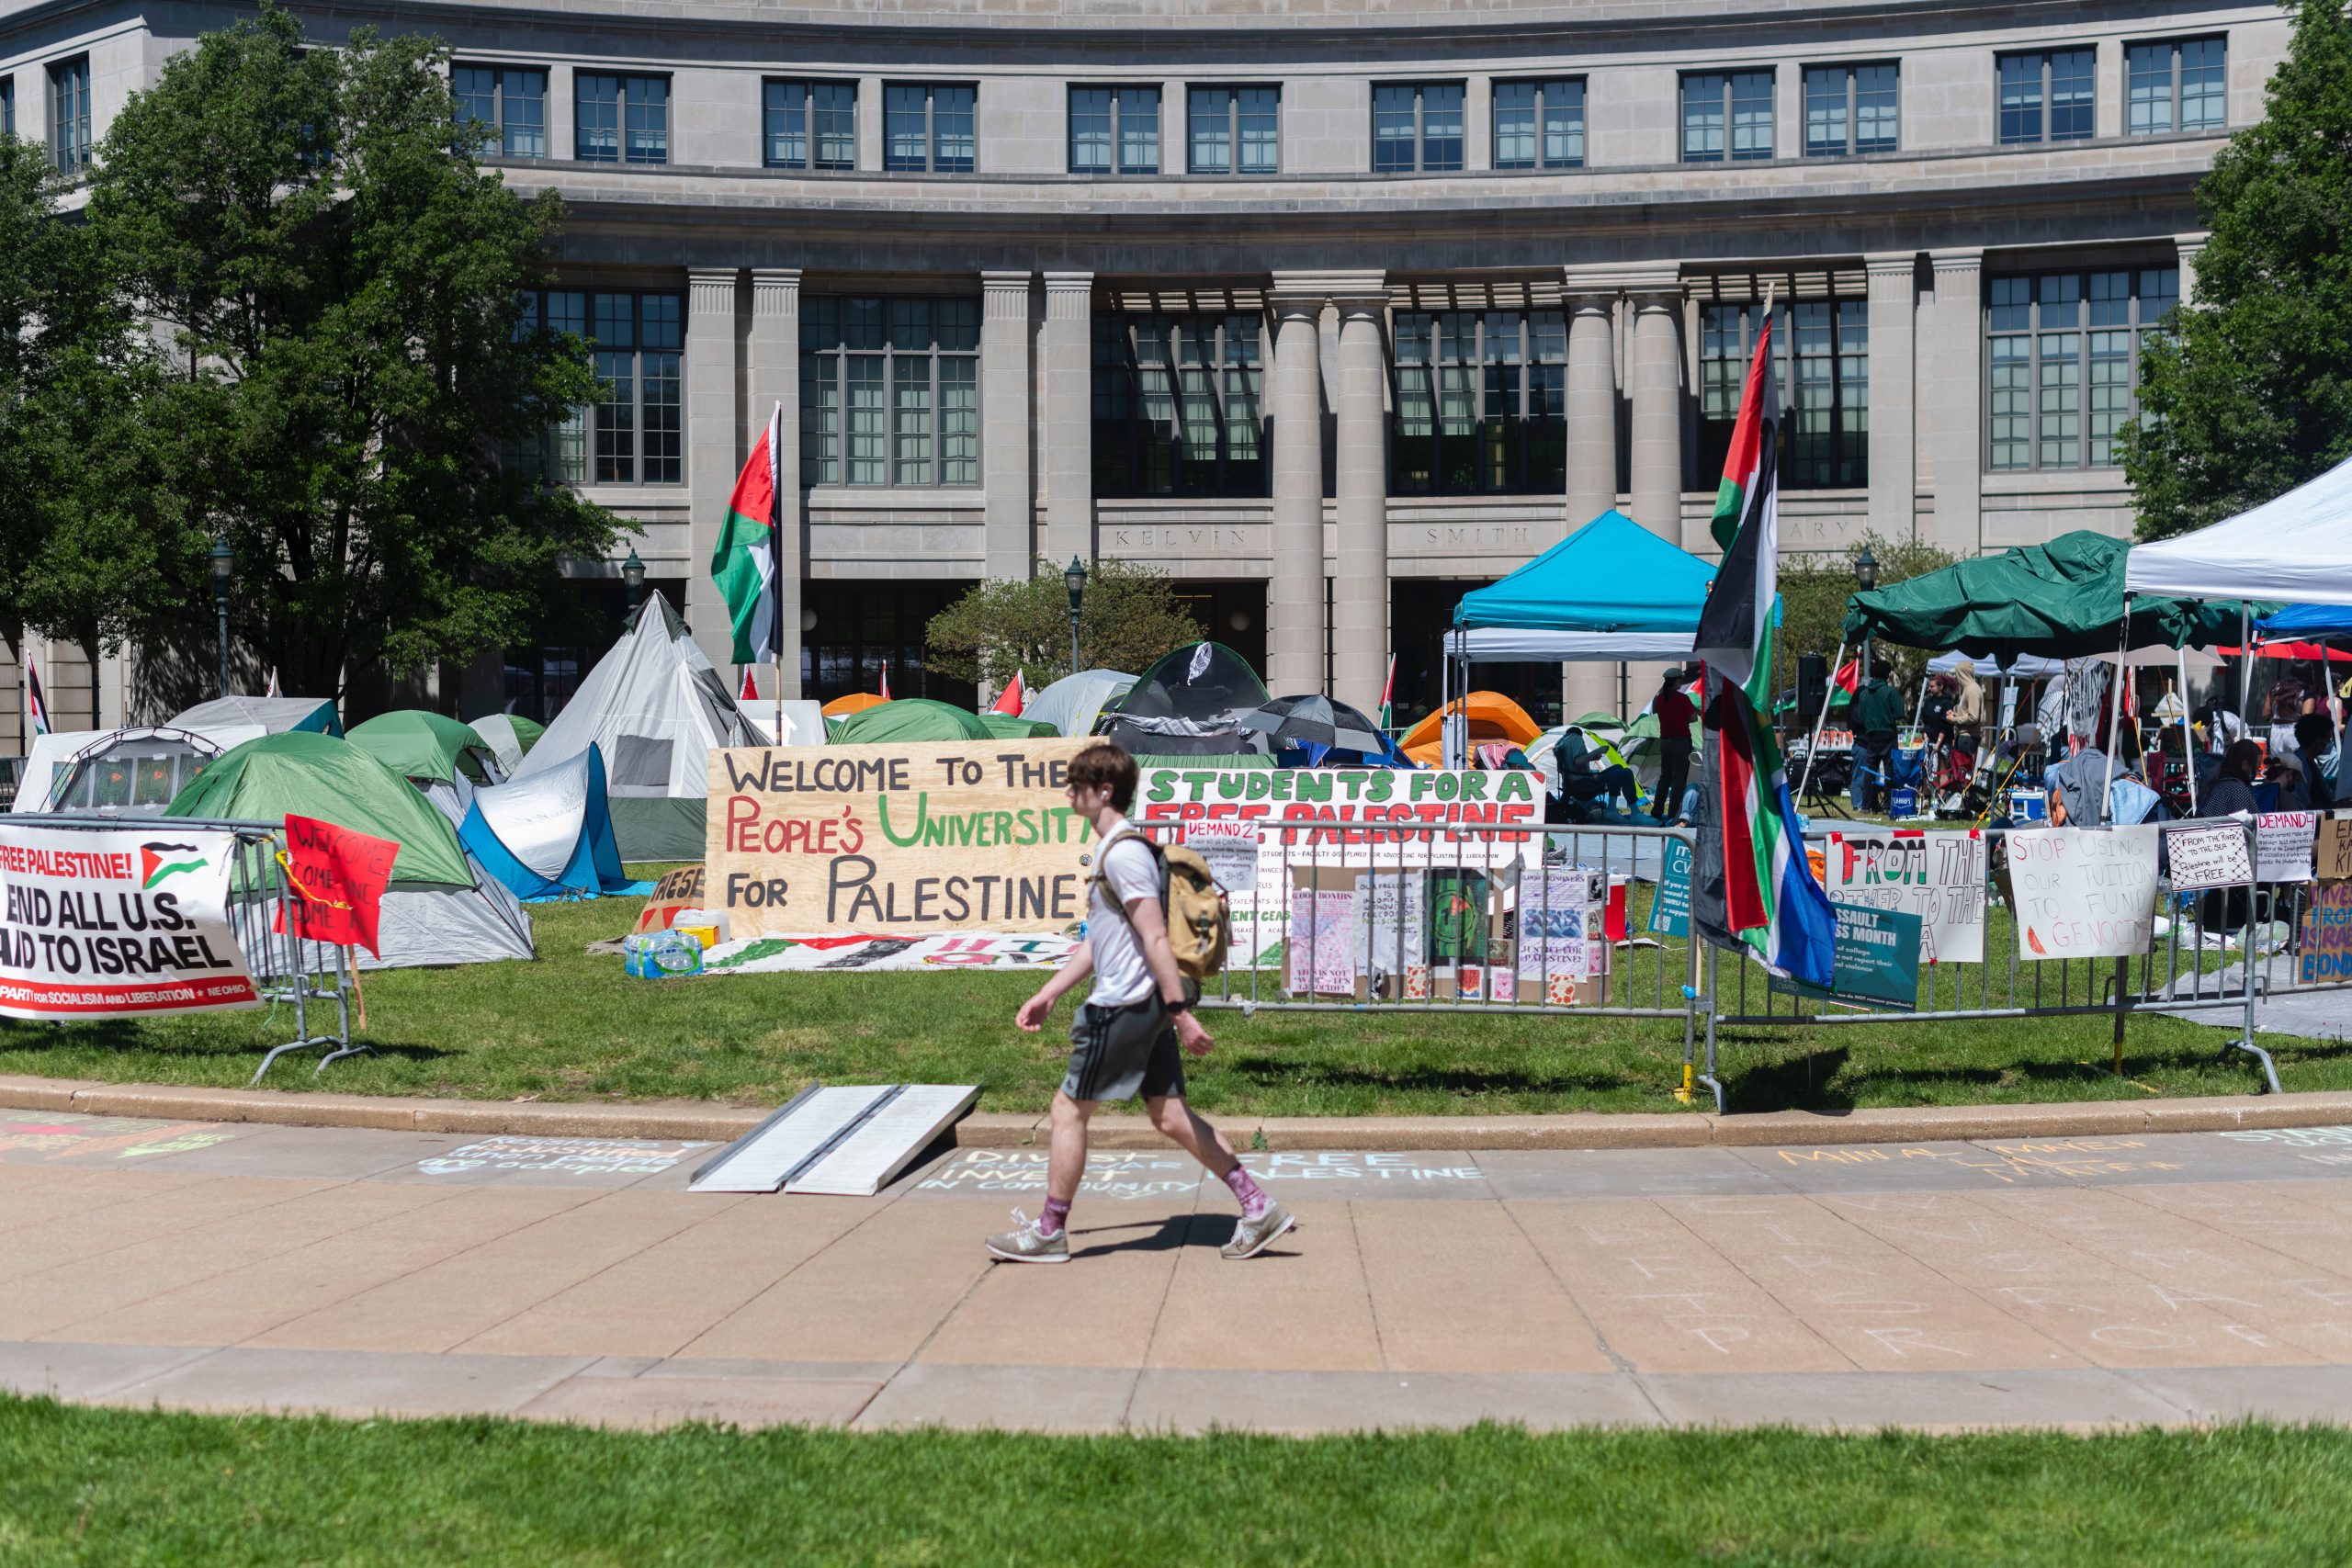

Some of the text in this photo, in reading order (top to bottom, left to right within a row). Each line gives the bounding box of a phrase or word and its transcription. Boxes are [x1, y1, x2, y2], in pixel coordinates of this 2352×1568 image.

[1114, 529, 1246, 547] KELVIN
[1426, 526, 1529, 544] SMITH
[724, 750, 1069, 793] WELCOME TO THE
[1146, 769, 1533, 803] STUDENTS FOR A
[726, 795, 864, 854] PEOPLE'S
[1189, 822, 1254, 839] DEMAND 2
[1282, 803, 1535, 846] PALESTINE
[2258, 813, 2314, 830] DEMAND 4
[2013, 834, 2144, 862] STOP USING
[2182, 836, 2205, 847] FROM
[2219, 831, 2237, 840] RIVER
[2213, 842, 2228, 851] SEA
[27, 850, 133, 880] PALESTINE!
[1842, 838, 1984, 886] FROM THE
[2178, 854, 2238, 872] Palestine will be
[2024, 862, 2154, 890] OUR TUITION
[2194, 868, 2226, 882] FREE
[727, 854, 1077, 924] FOR PALESTINE
[6, 883, 198, 932] END ALL U.S.
[1947, 885, 1985, 925] THE
[2028, 889, 2146, 919] TO FUND
[1852, 925, 1896, 947] MONTH
[2052, 917, 2151, 948] GENOCIDE
[39, 932, 82, 975] TO
[85, 935, 234, 975] ISRAEL
[1845, 947, 1871, 956] college
[1845, 963, 1874, 973] violence
[1854, 955, 1875, 965] report
[1876, 958, 1894, 967] their
[1329, 969, 1347, 977] NOT
[34, 993, 48, 1003] FOR
[48, 989, 105, 1005] SOCIALISM
[105, 993, 126, 1005] AND
[125, 987, 196, 1005] LIBERATION
[208, 986, 222, 997] NE
[221, 984, 247, 996] OHIO
[480, 1135, 662, 1148] Resistance
[417, 1158, 487, 1168] are
[447, 1150, 679, 1167] when people
[965, 1149, 1159, 1163] DIVST
[940, 1168, 1131, 1182] INVET
[917, 1179, 960, 1190] IN
